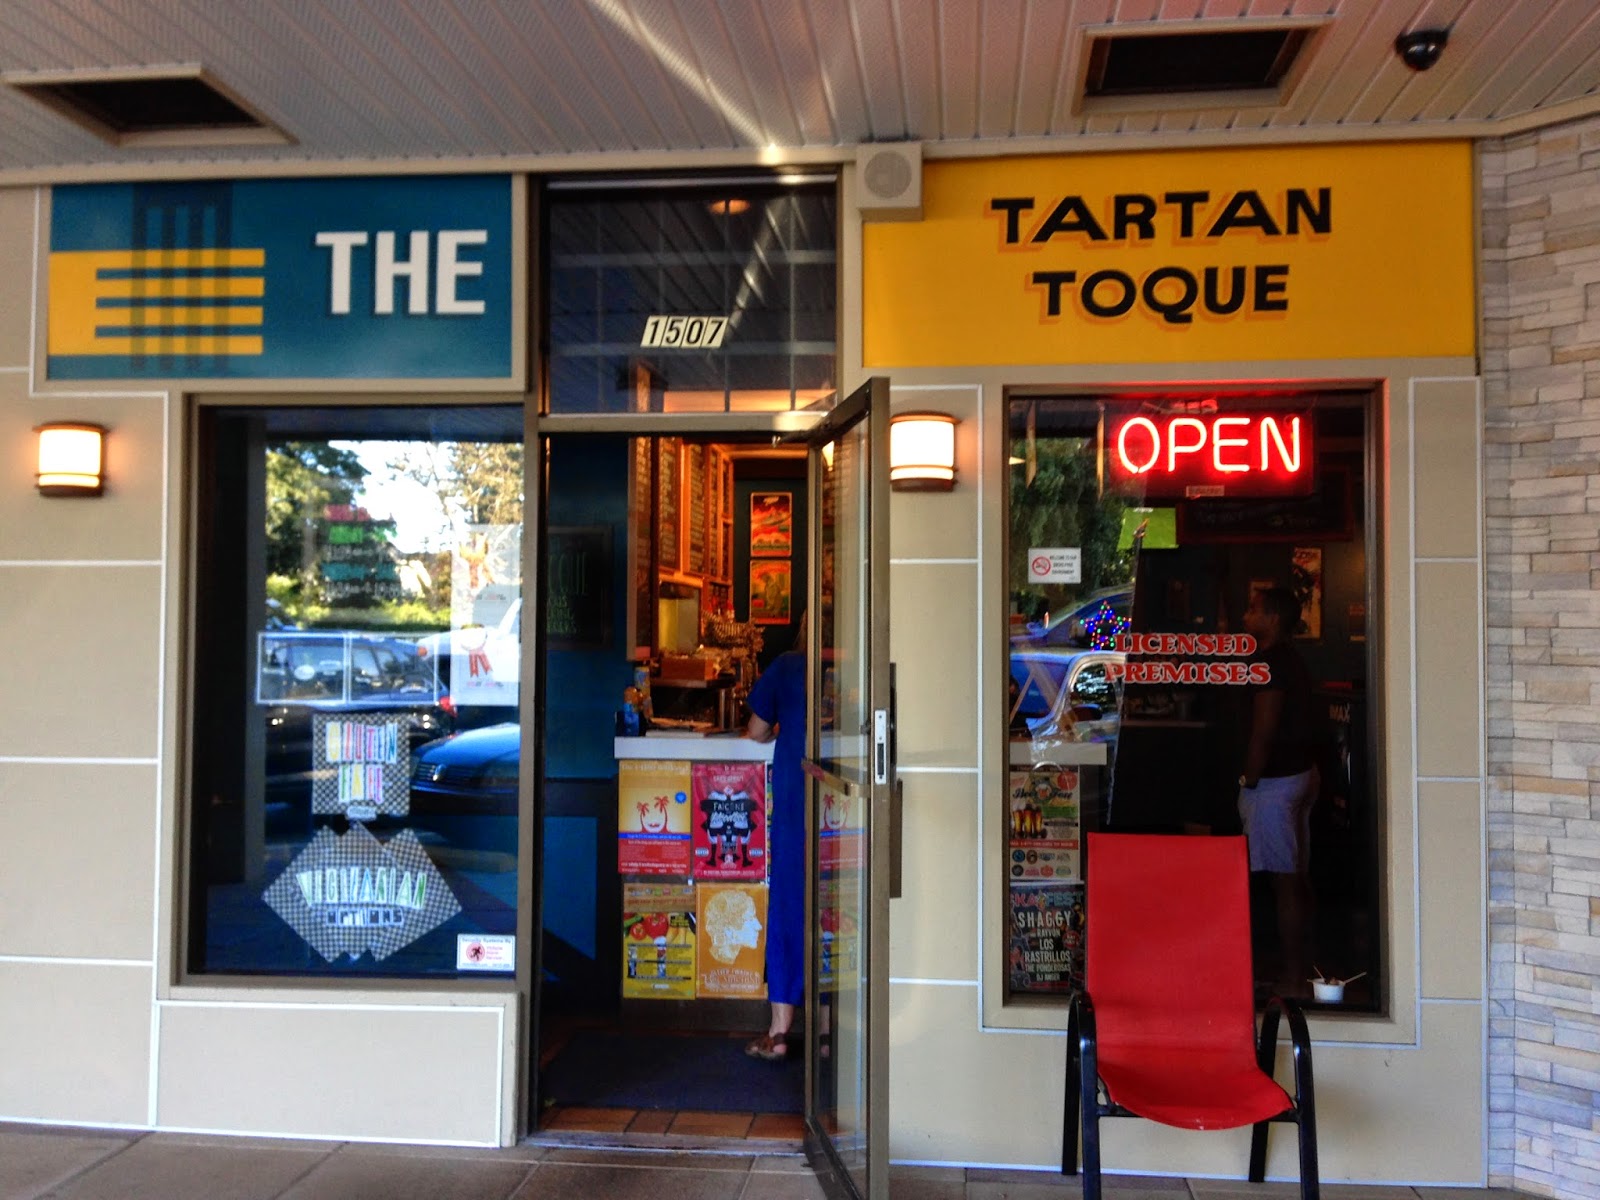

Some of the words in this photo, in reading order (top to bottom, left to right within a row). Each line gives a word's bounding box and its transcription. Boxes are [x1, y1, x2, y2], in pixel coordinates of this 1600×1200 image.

[986, 186, 1332, 249] TARTAN
[315, 230, 489, 315] THE
[1027, 264, 1290, 328] TOQUE
[648, 318, 724, 346] 1507
[1117, 416, 1301, 475] OPEN
[1113, 632, 1257, 656] LICENSED
[1103, 661, 1271, 685] PREMISES
[1018, 910, 1071, 928] SHAGGY
[1024, 950, 1071, 964] RASTRILLOS
[1039, 938, 1054, 950] LOS
